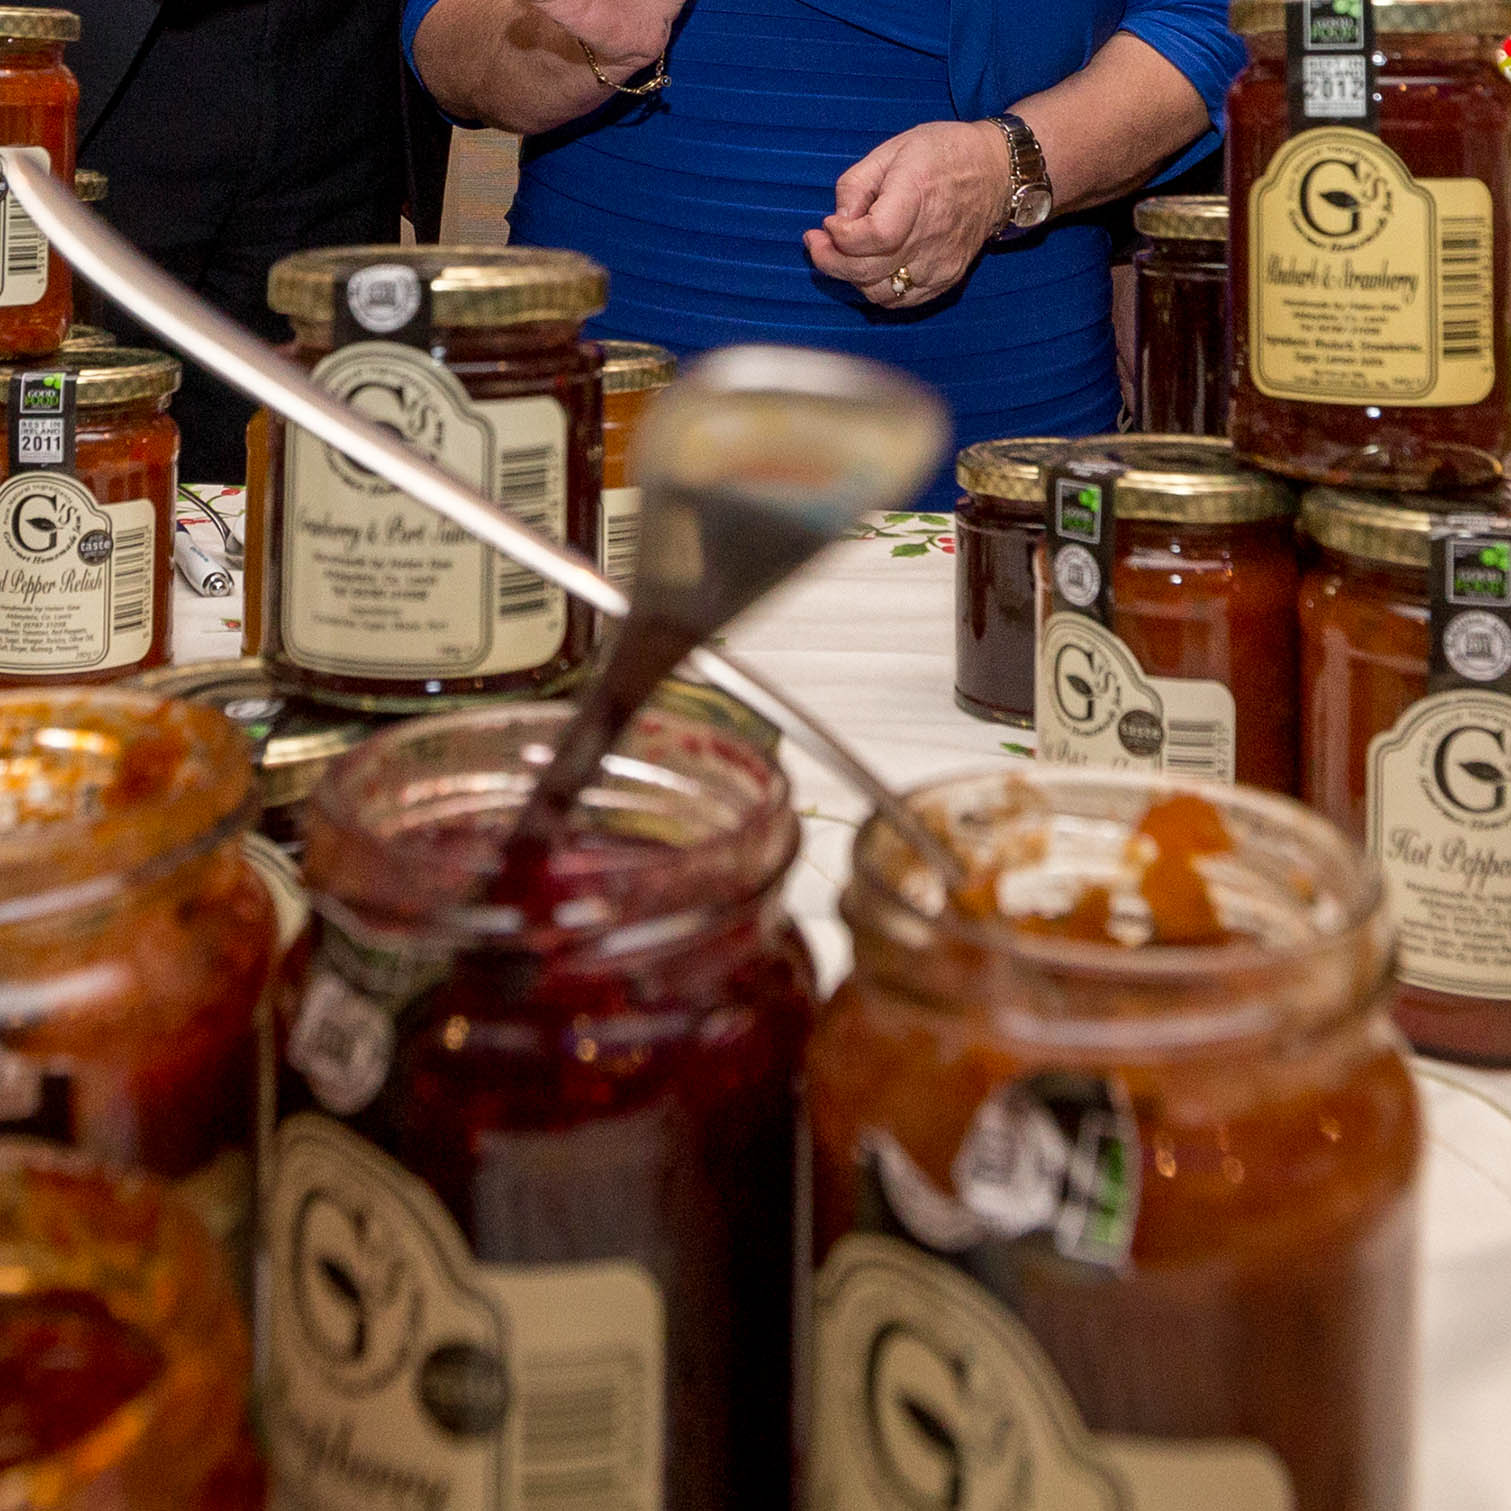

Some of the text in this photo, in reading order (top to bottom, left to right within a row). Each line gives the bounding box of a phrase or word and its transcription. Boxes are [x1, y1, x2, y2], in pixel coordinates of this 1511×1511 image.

[1300, 158, 1388, 237] G's
[21, 437, 61, 451] 2011
[12, 494, 77, 552] G's
[80, 539, 111, 552] taste
[9, 570, 56, 604] Pepper
[59, 567, 103, 594] Relish
